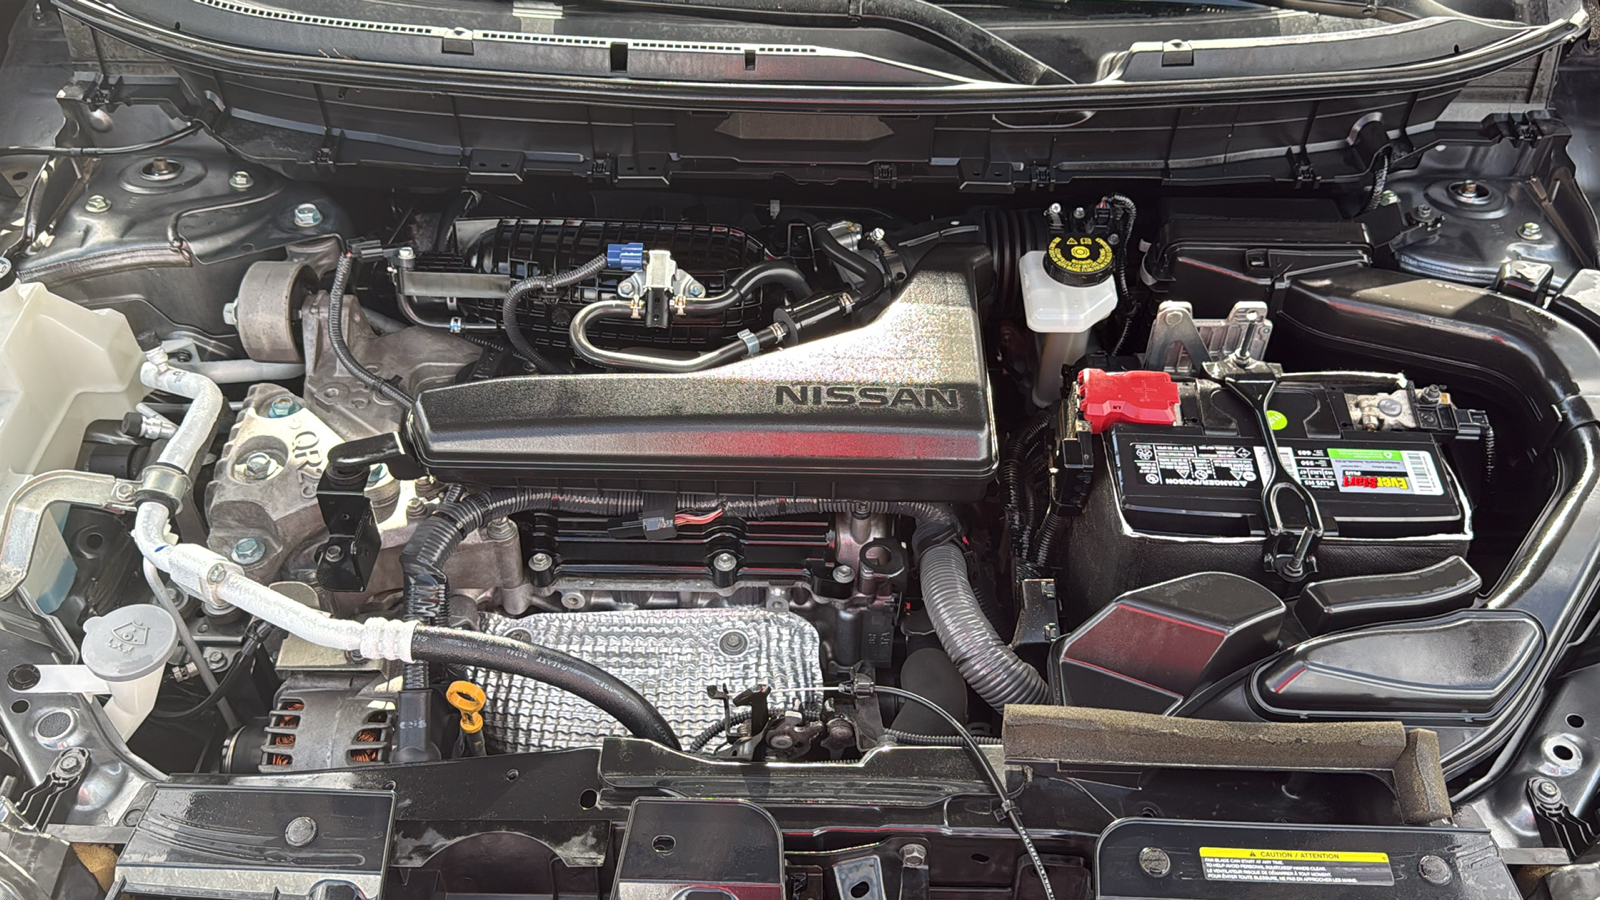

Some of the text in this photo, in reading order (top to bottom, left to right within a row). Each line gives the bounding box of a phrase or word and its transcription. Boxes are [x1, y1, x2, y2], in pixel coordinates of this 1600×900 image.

[776, 386, 958, 408] NISSAN
[1342, 476, 1408, 490] EverStart
[537, 656, 568, 671] GALAXY
